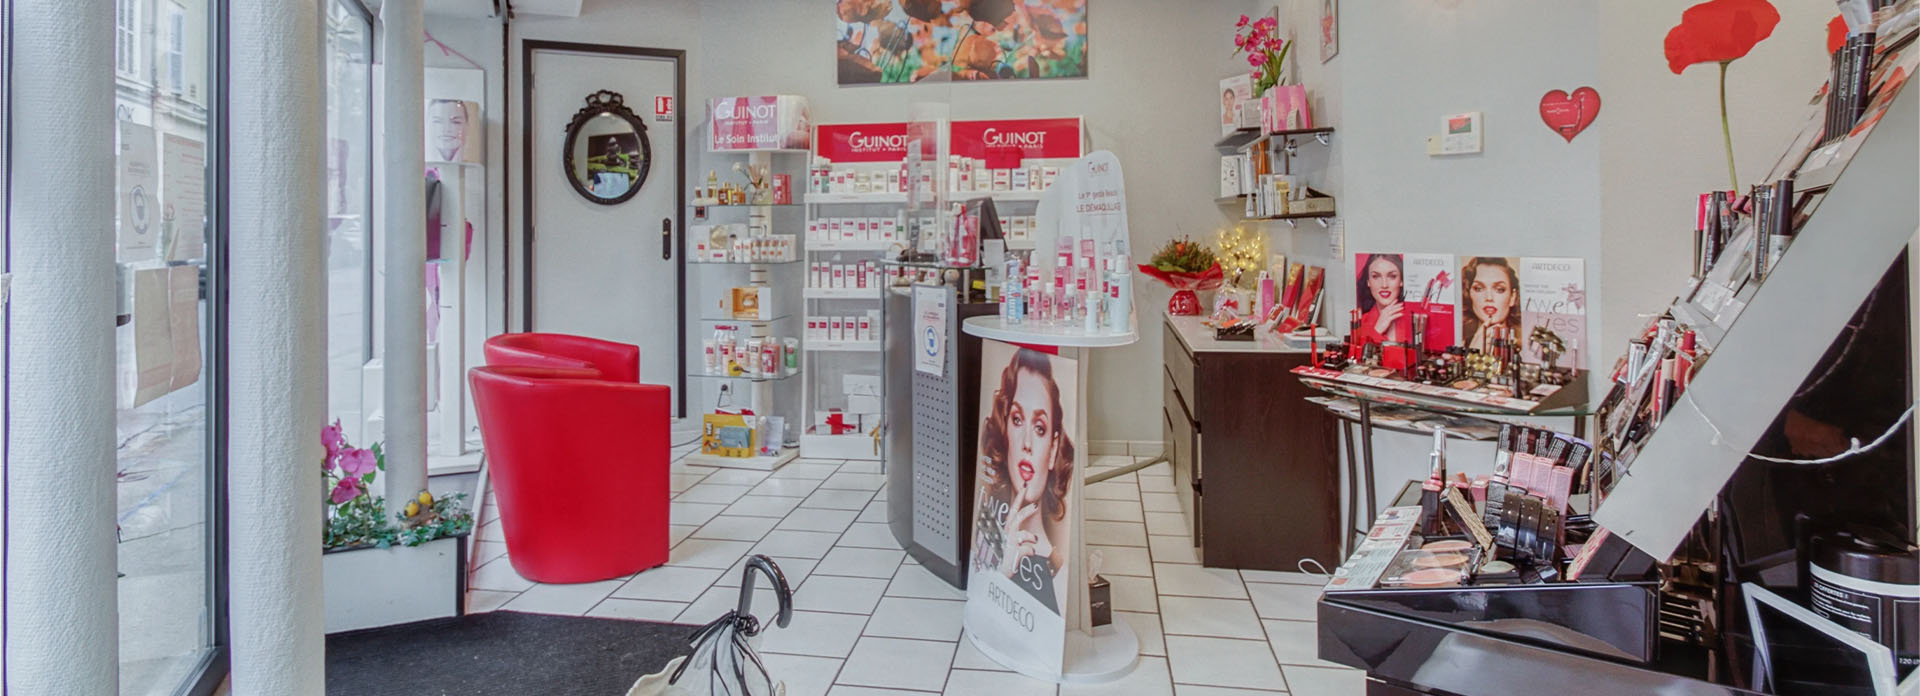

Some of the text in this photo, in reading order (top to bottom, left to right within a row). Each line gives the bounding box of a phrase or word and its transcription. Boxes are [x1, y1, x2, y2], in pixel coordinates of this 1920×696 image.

[715, 102, 776, 119] GUINOT
[714, 135, 725, 144] Le
[727, 134, 745, 143] Soin
[848, 131, 909, 148] GUINOT
[983, 128, 1047, 145] GUINOT
[1532, 262, 1571, 271] ARTDECO
[987, 581, 1035, 633] ARTDECO
